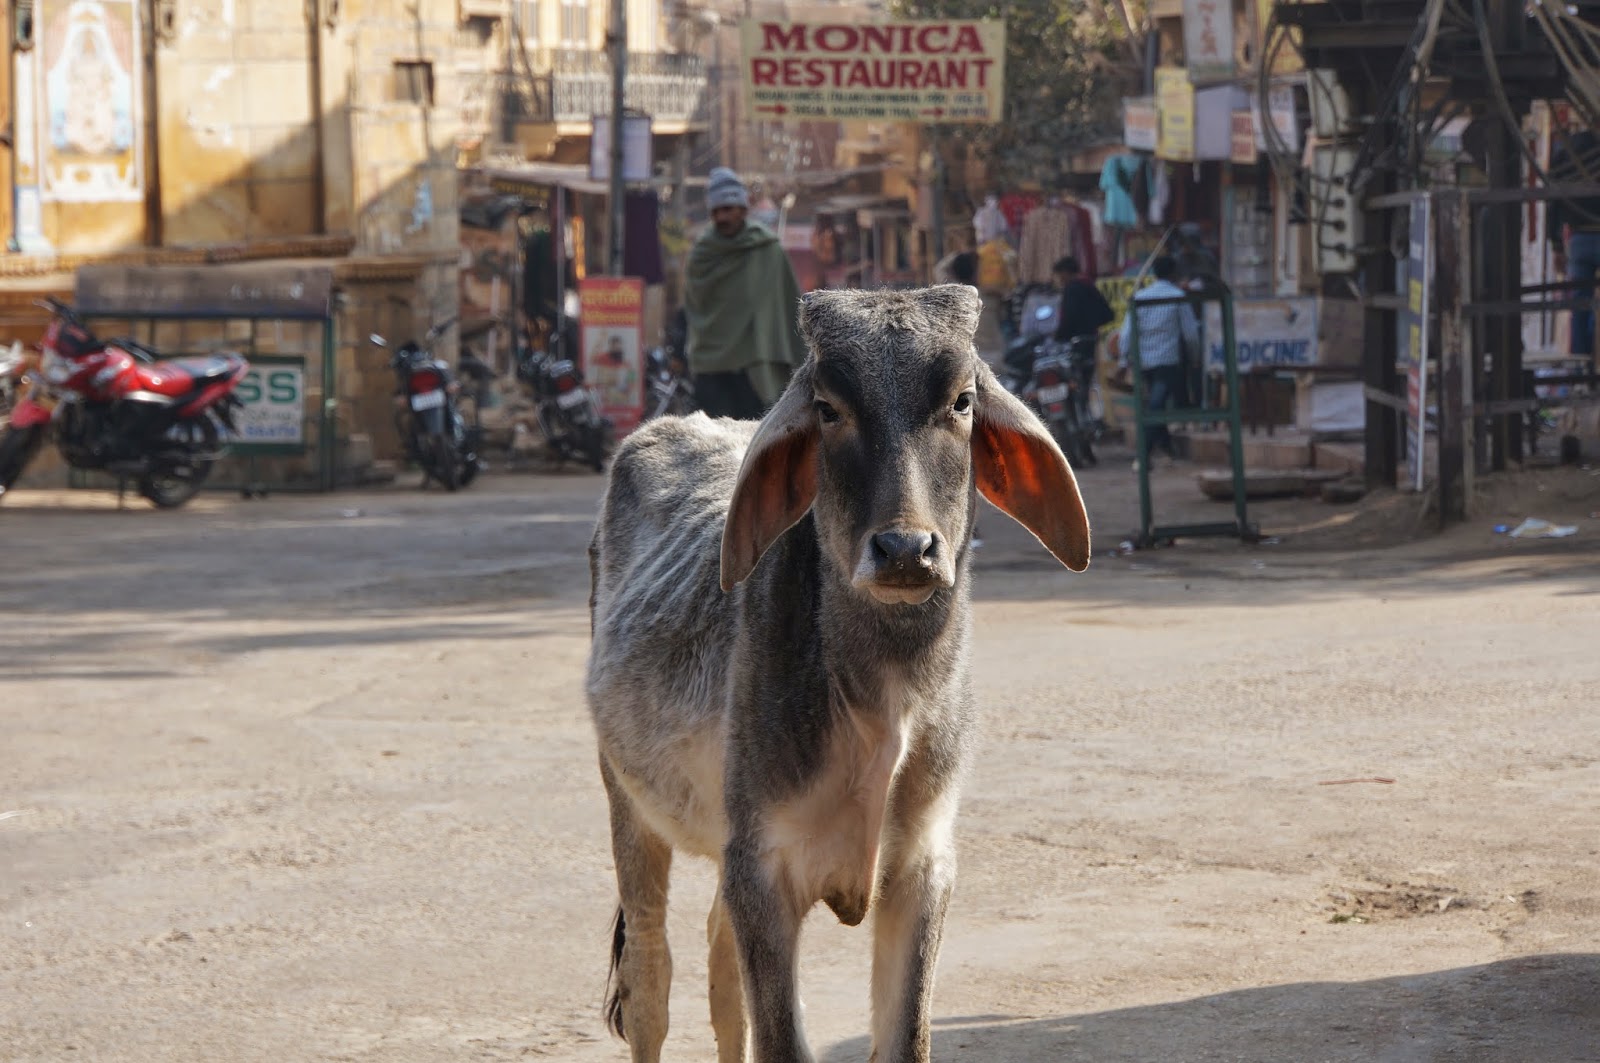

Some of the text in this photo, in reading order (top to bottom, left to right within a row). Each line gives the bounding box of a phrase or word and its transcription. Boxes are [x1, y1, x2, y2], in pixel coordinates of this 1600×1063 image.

[761, 23, 985, 54] MONICA
[752, 58, 993, 89] RESTAURANT
[1210, 340, 1311, 364] MDICINE
